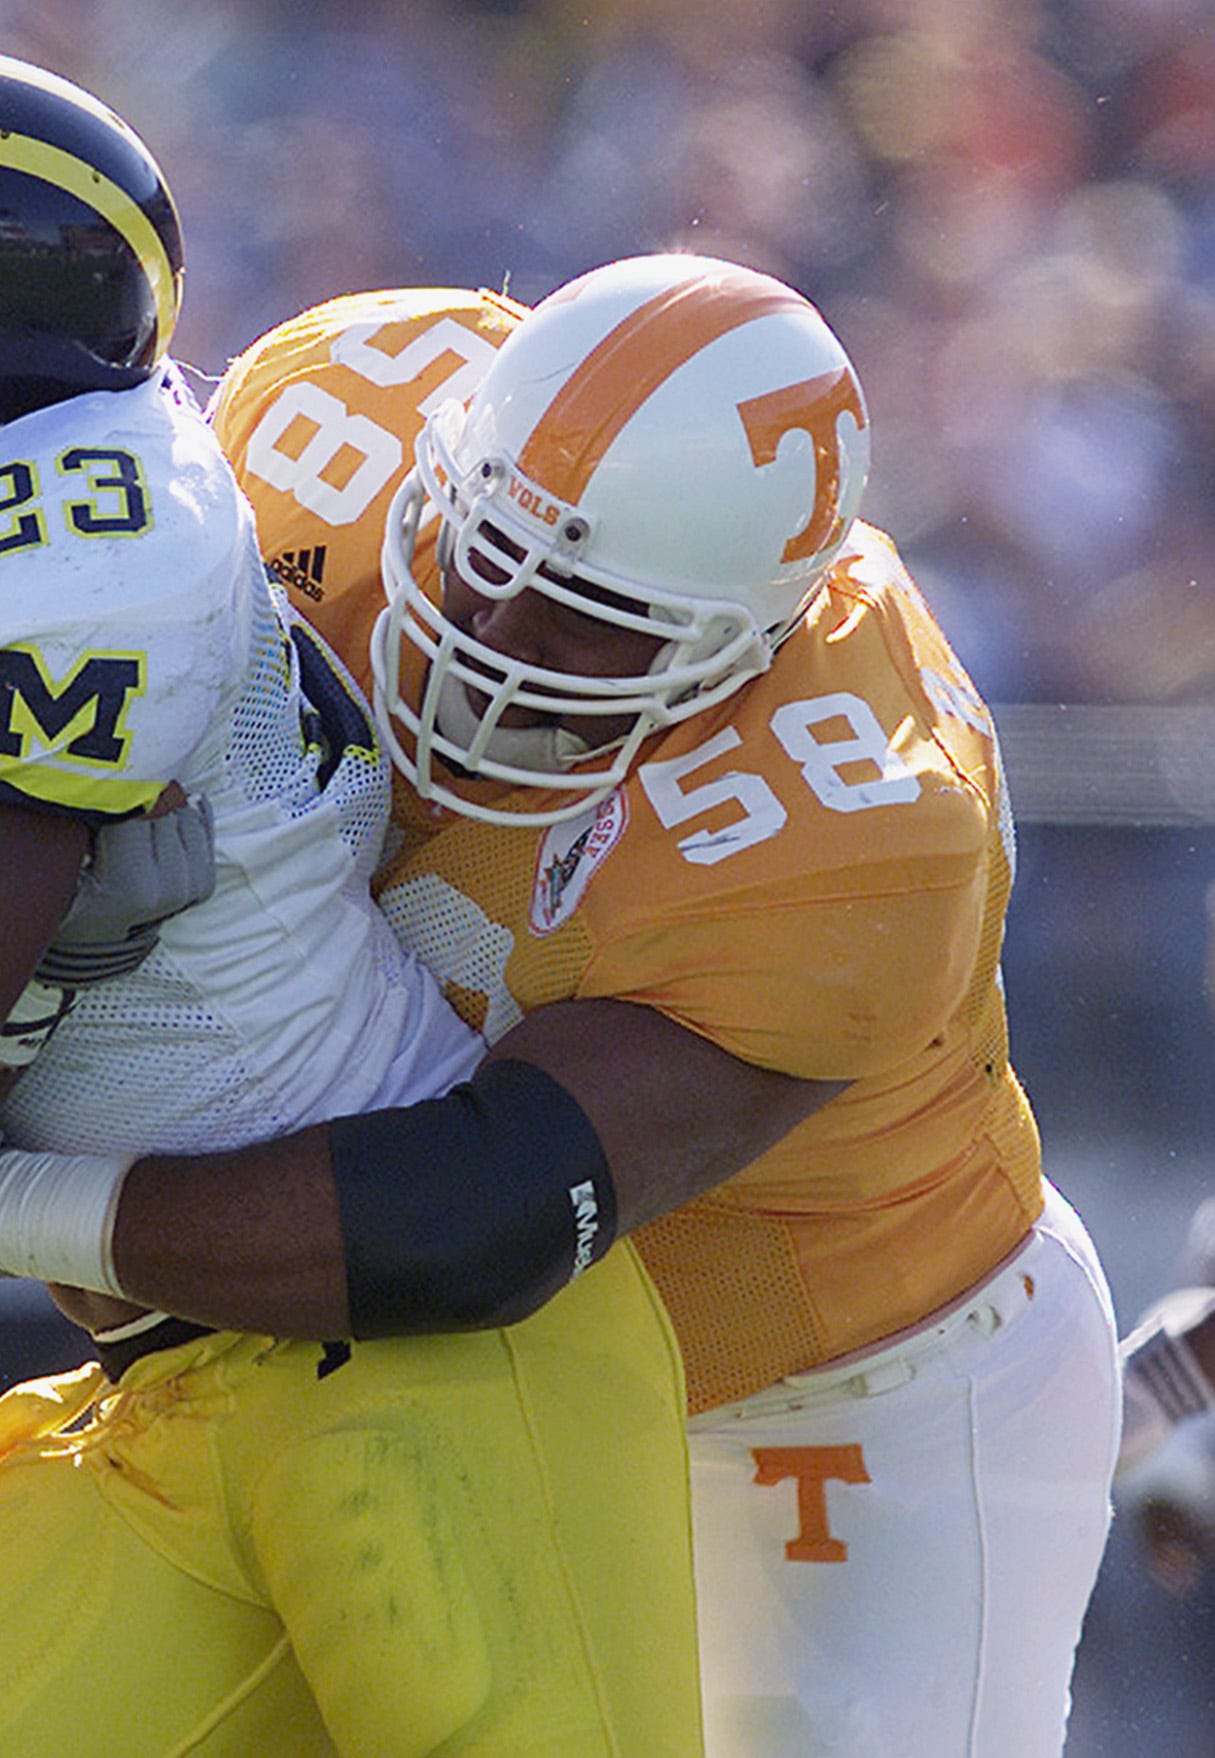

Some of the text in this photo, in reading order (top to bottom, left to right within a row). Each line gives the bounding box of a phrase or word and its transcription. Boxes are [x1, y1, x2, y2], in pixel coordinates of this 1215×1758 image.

[507, 474, 561, 528] VOLS
[735, 366, 868, 564] T
[269, 558, 326, 603] adidas
[636, 690, 922, 866] 58
[751, 1443, 873, 1564] T
